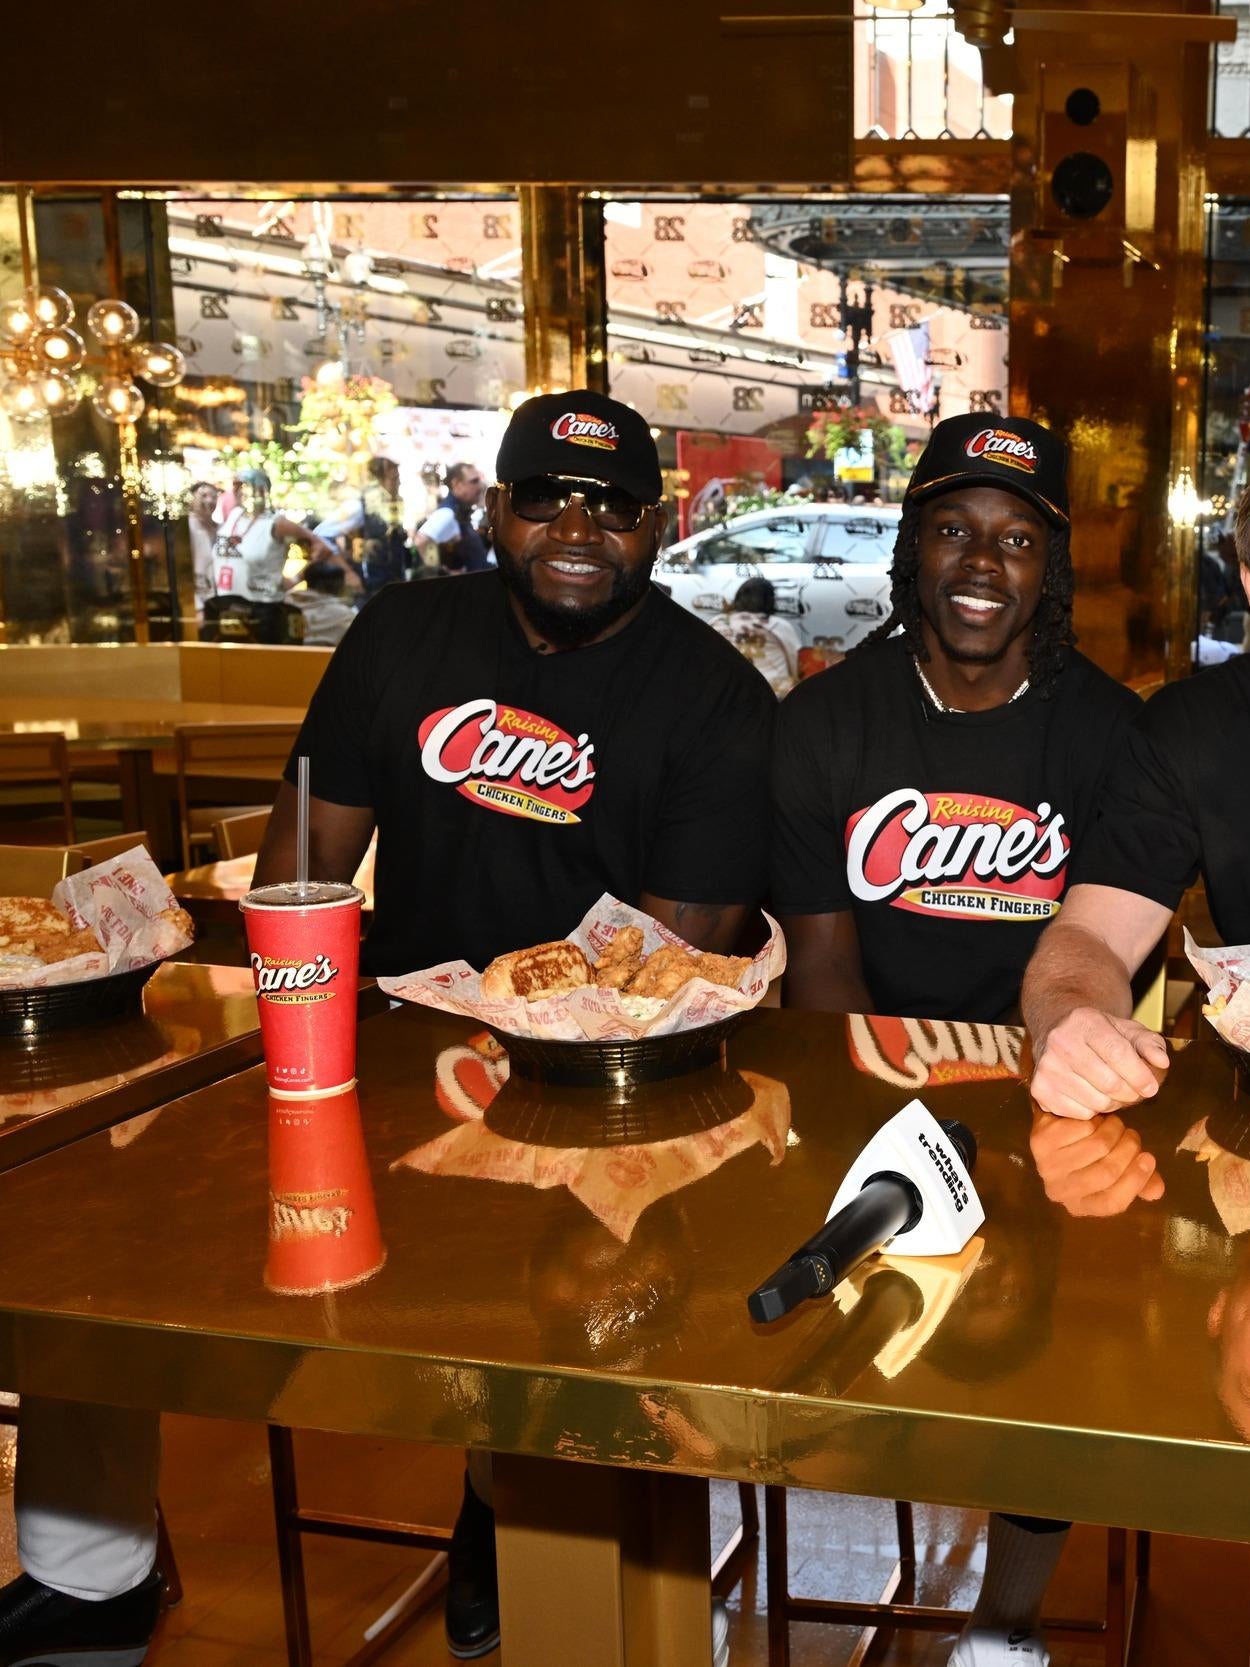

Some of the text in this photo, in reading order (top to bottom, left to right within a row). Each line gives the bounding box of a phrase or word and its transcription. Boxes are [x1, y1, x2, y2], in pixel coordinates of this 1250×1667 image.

[552, 413, 619, 440] Cane's
[966, 429, 1037, 458] Cane's
[421, 699, 596, 789] Cane's
[498, 709, 559, 744] Raising
[476, 783, 567, 822] CHICKEN FINGERS
[932, 797, 1015, 826] Raising
[847, 788, 1070, 901] Cane's
[921, 890, 1051, 915] CHICKEN FINGERS
[264, 957, 303, 968] Raising
[918, 1132, 964, 1213] trending
[935, 1142, 969, 1205] what's
